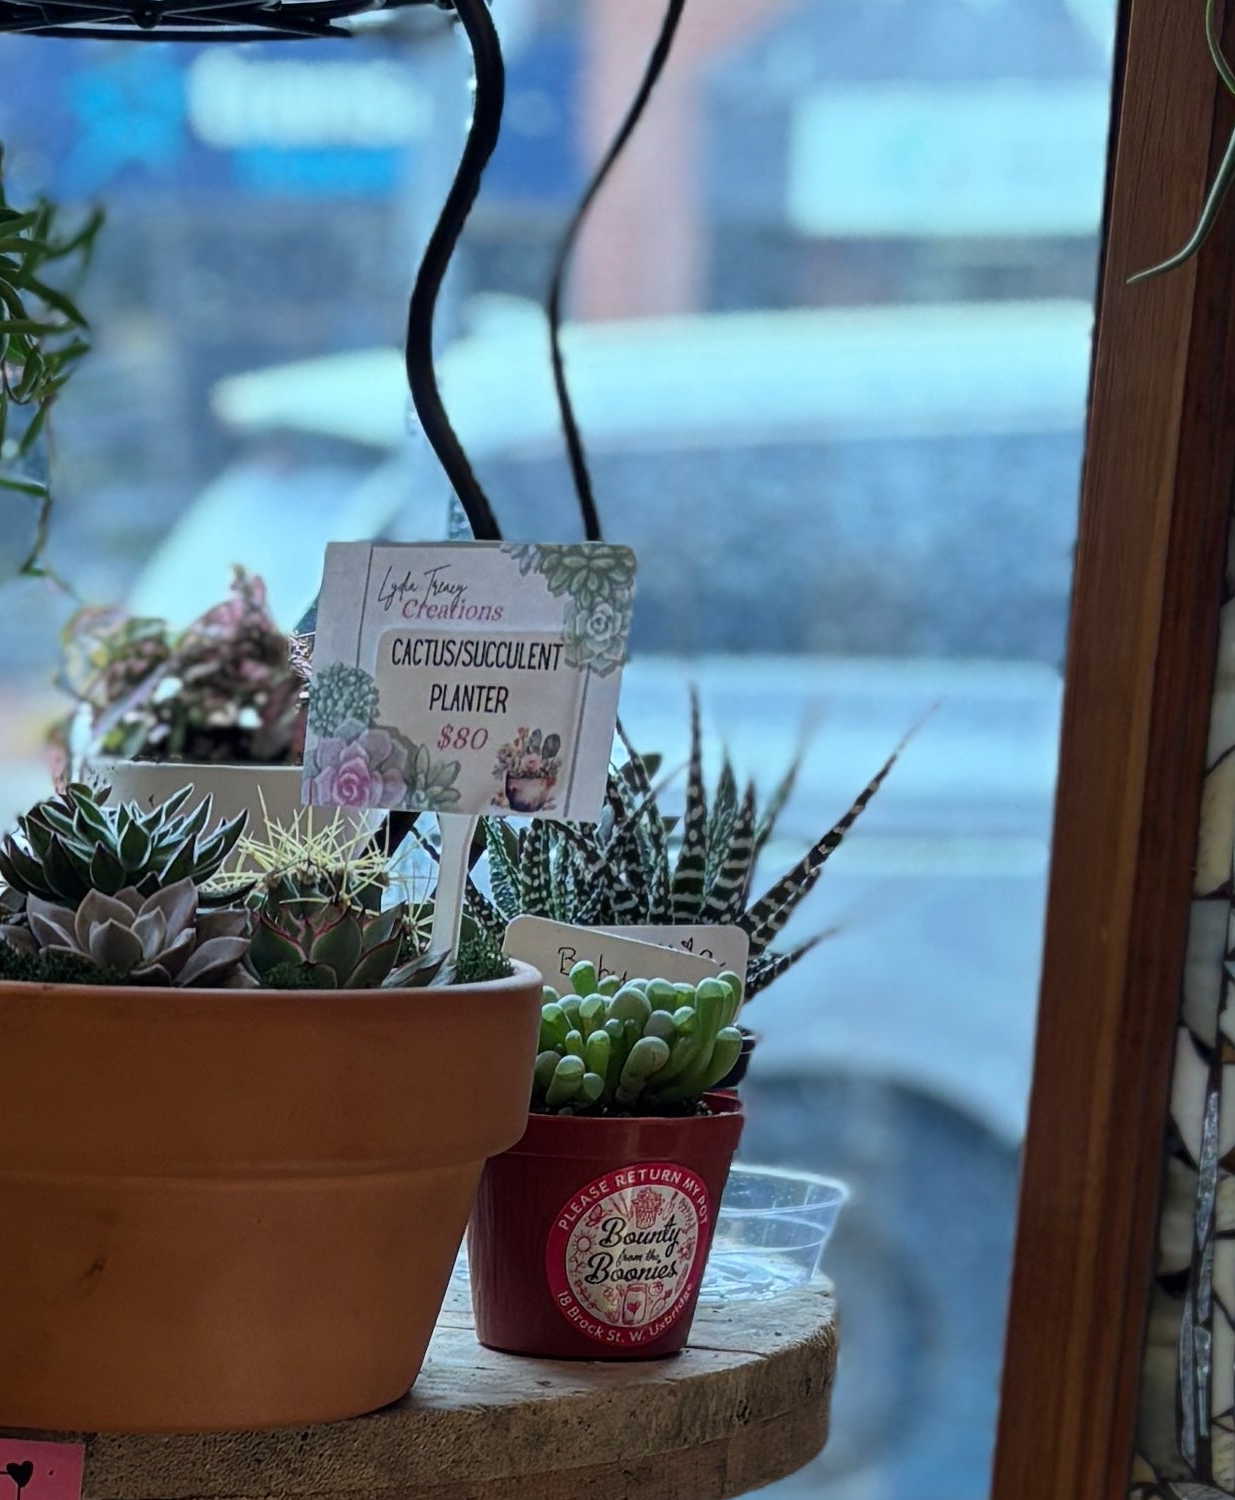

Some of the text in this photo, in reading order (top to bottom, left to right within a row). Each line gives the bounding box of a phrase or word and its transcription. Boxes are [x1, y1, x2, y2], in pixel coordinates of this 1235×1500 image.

[402, 598, 504, 621] Creations
[392, 638, 564, 671] CACTUS/SUCCULENT
[429, 684, 509, 714] PLANTER
[437, 723, 489, 752] $80
[558, 1168, 708, 1231] PLEASE RETURN MY POT
[599, 1213, 681, 1257] Bounty
[584, 1251, 678, 1285] Boonies
[616, 1247, 660, 1267] from the
[557, 1291, 569, 1307] 18
[567, 1303, 603, 1339] Brock
[629, 1330, 645, 1342] W.
